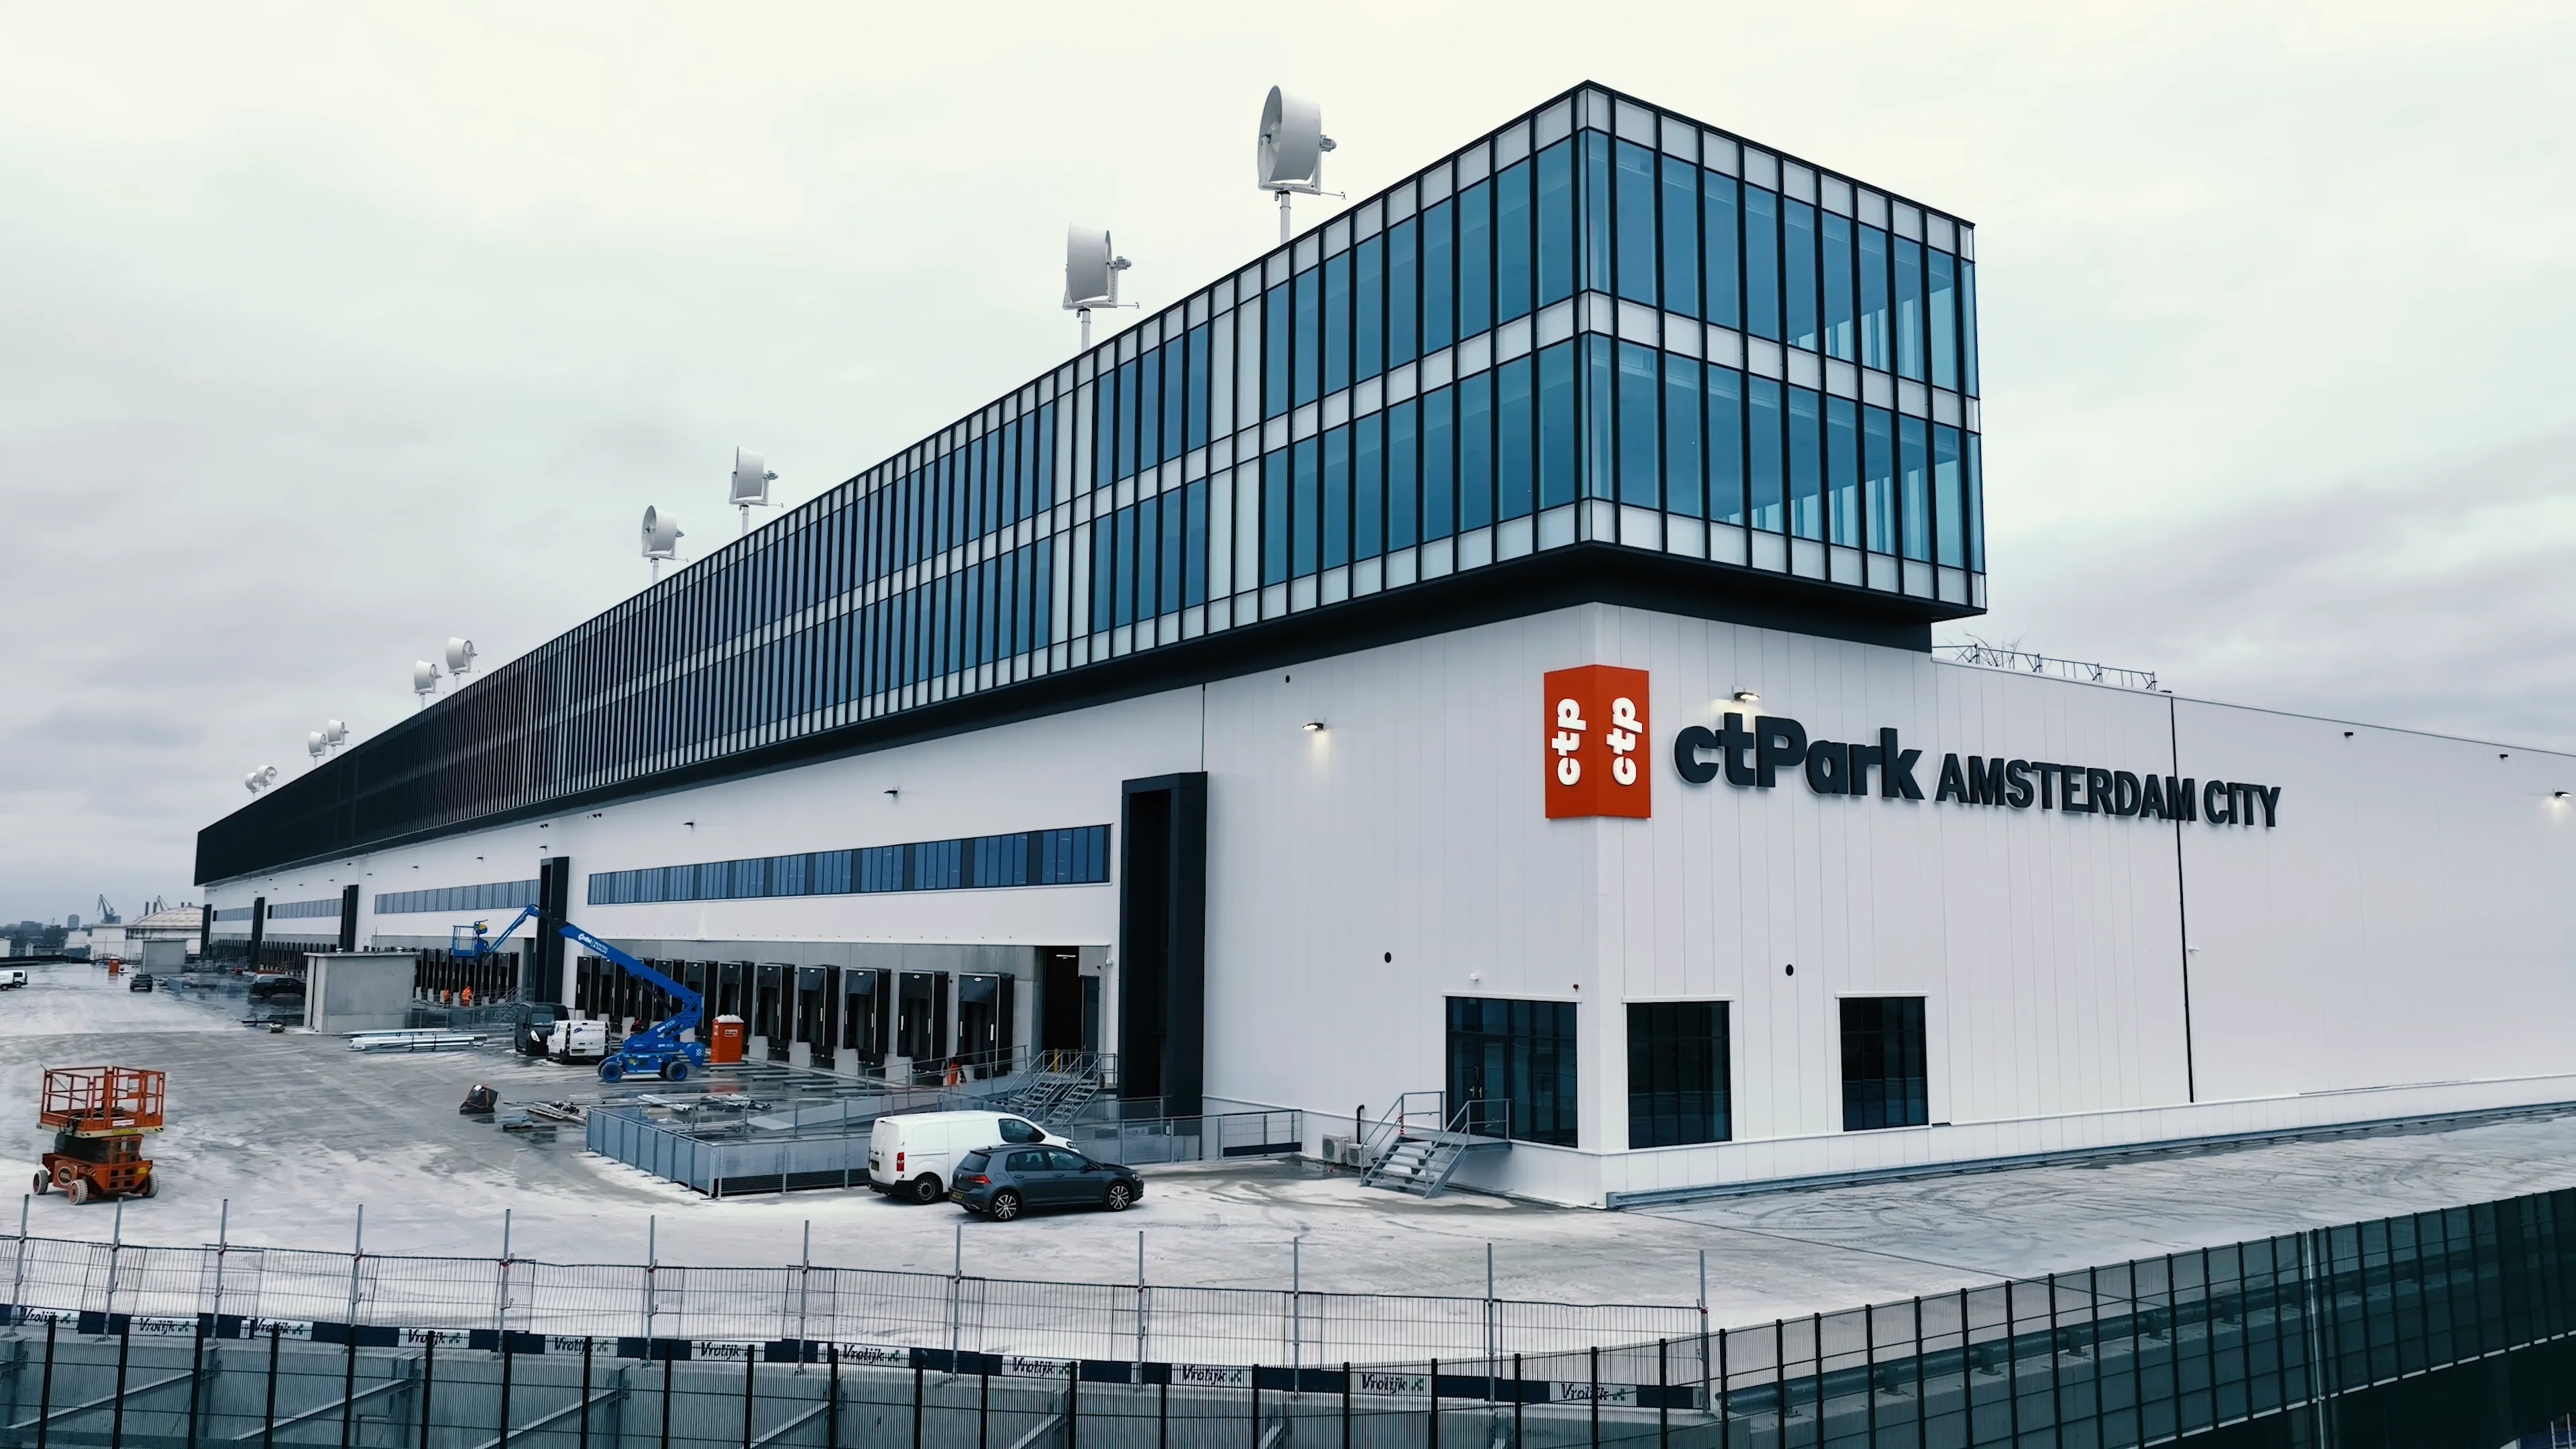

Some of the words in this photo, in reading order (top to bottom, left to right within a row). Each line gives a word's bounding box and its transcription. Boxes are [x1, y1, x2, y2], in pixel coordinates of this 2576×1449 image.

[1551, 698, 1587, 786] ctp
[1606, 697, 1643, 786] ctp
[1674, 712, 1925, 800] ctPark
[1935, 753, 2197, 822] AMSTERDAM
[2203, 780, 2282, 828] CITY
[255, 1318, 290, 1337] Vrojk
[701, 1342, 741, 1360] Vrolijk
[843, 1344, 884, 1363] Vrolijk
